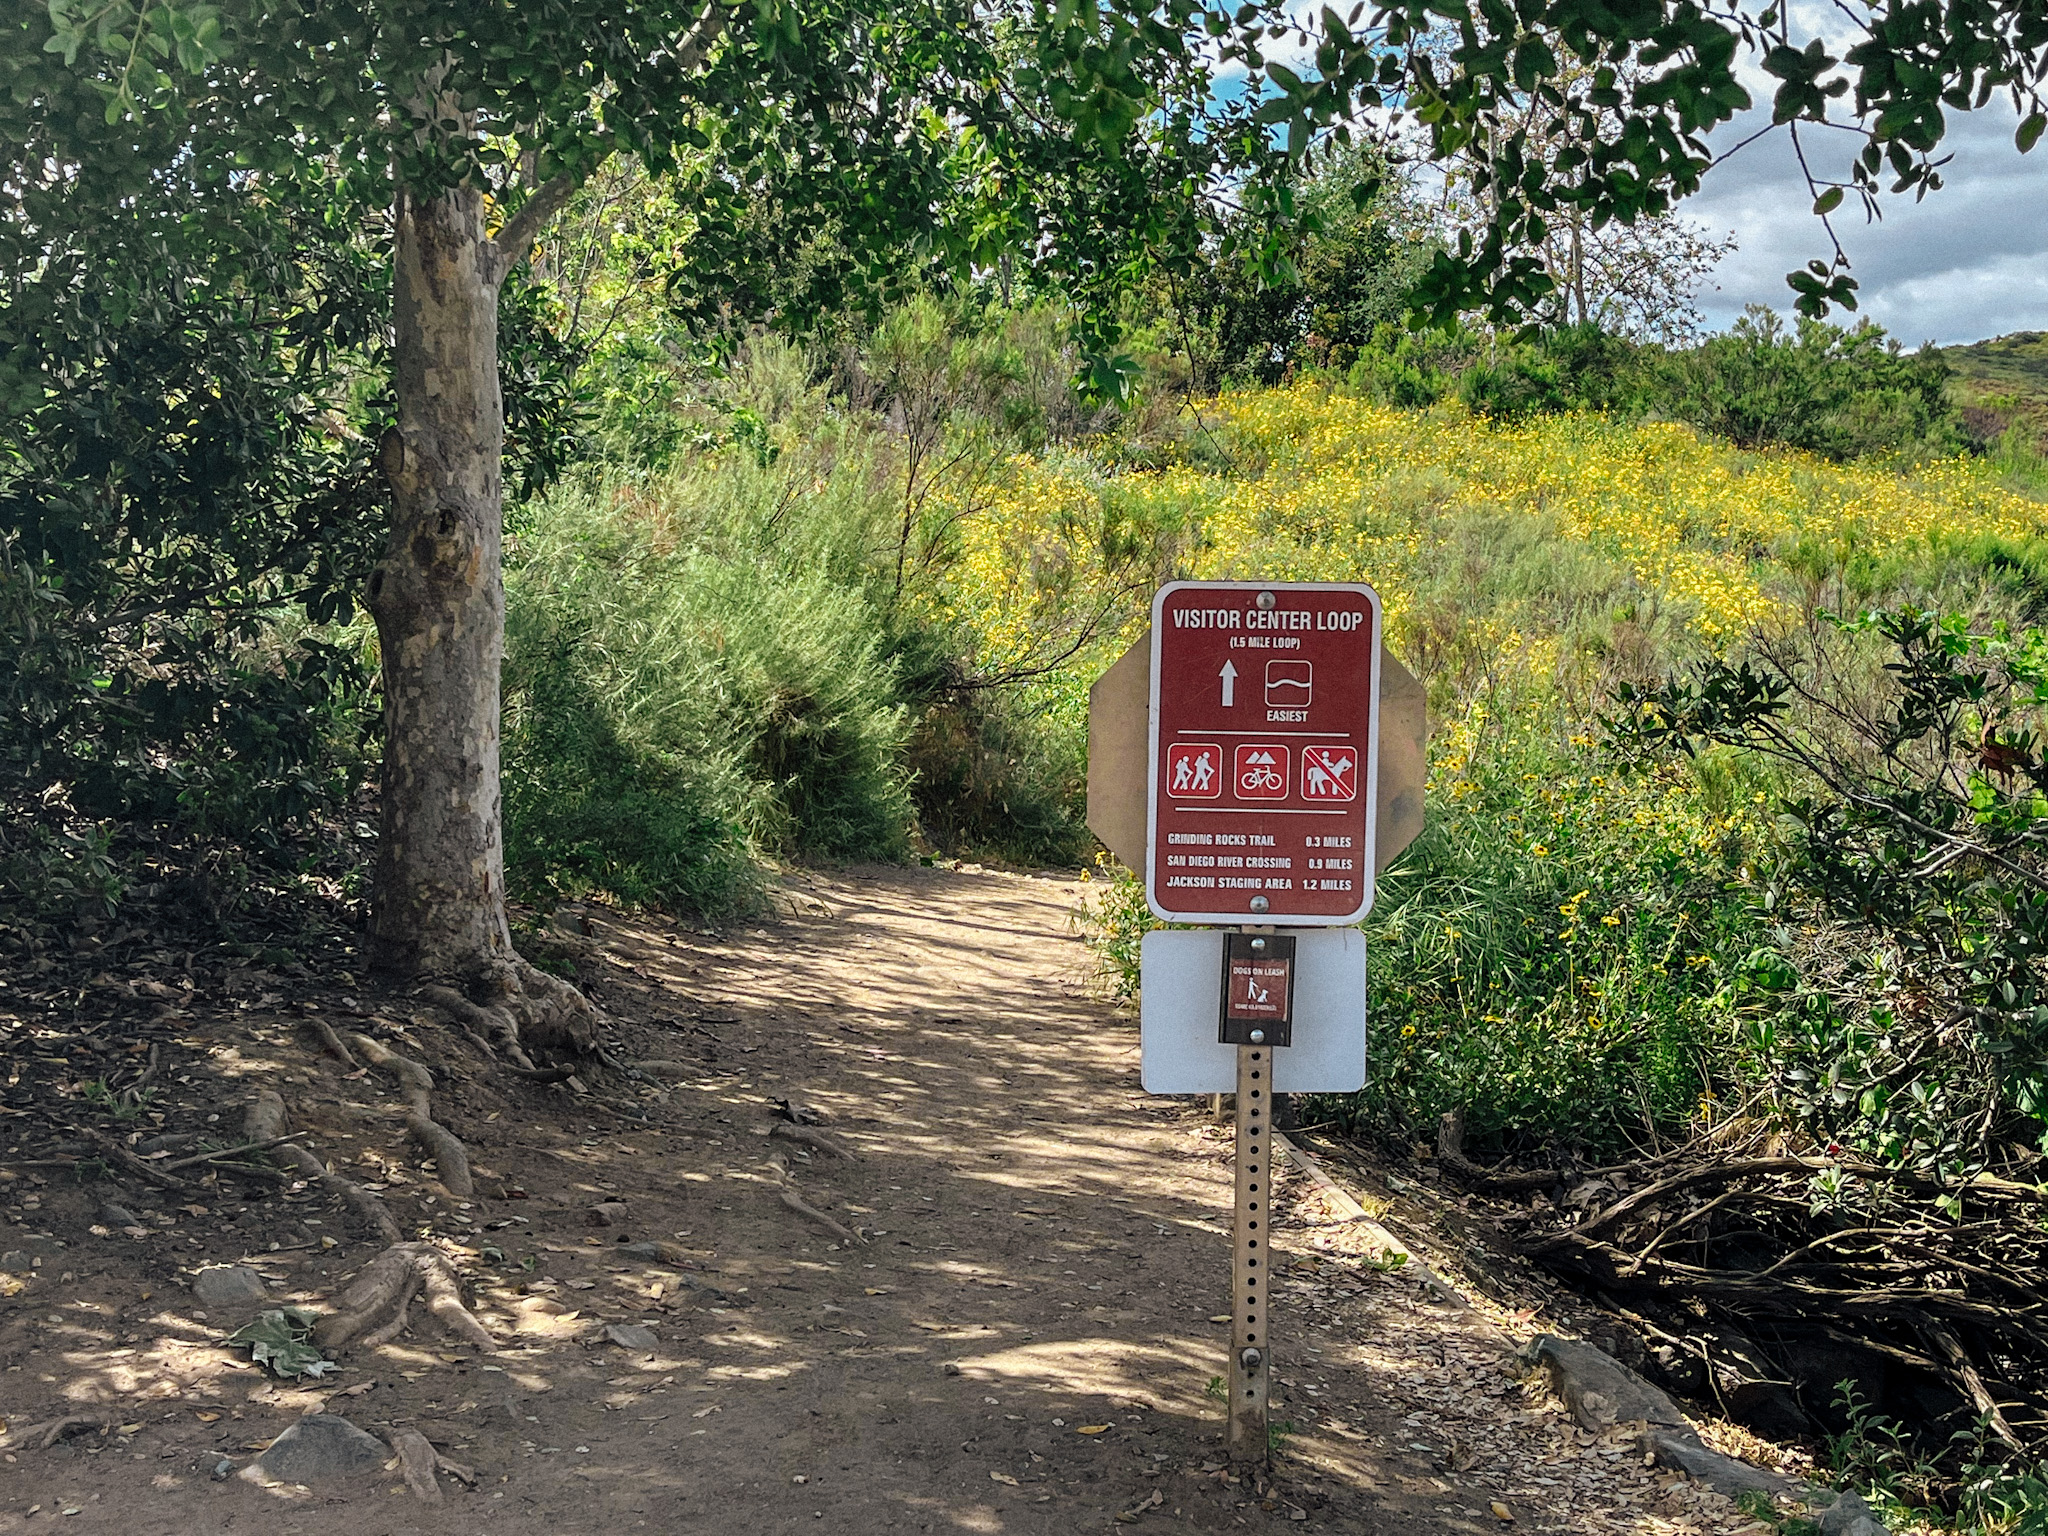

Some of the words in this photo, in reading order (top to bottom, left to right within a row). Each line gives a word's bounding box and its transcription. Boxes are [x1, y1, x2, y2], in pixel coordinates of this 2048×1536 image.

[1173, 609, 1241, 629] VISITOR
[1246, 610, 1312, 630] CENTER
[1316, 611, 1364, 631] LOOP
[1230, 637, 1246, 649] (1.5
[1248, 637, 1270, 649] MILE
[1273, 637, 1301, 650] LOOP)
[1266, 710, 1308, 723] EASIEST
[1167, 833, 1213, 845] GRINDING
[1215, 834, 1247, 846] ROCKS
[1249, 835, 1276, 846] TRAIL
[1305, 836, 1320, 847] 0.3
[1323, 836, 1352, 848] MILES
[1167, 855, 1186, 866] SAN
[1188, 855, 1215, 867] DIEGO
[1217, 856, 1243, 868] RIVER
[1246, 857, 1292, 869] CROSSING
[1308, 858, 1323, 869] 0.9
[1325, 859, 1353, 870] MILES
[1166, 876, 1215, 888] JACKSON
[1218, 877, 1262, 889] STAGING
[1264, 878, 1293, 890] AREA
[1302, 879, 1318, 890] 1.2
[1320, 879, 1352, 891] MILES
[1233, 967, 1251, 975] DOGS
[1252, 967, 1263, 976] ON
[1264, 968, 1285, 976] LEASH
